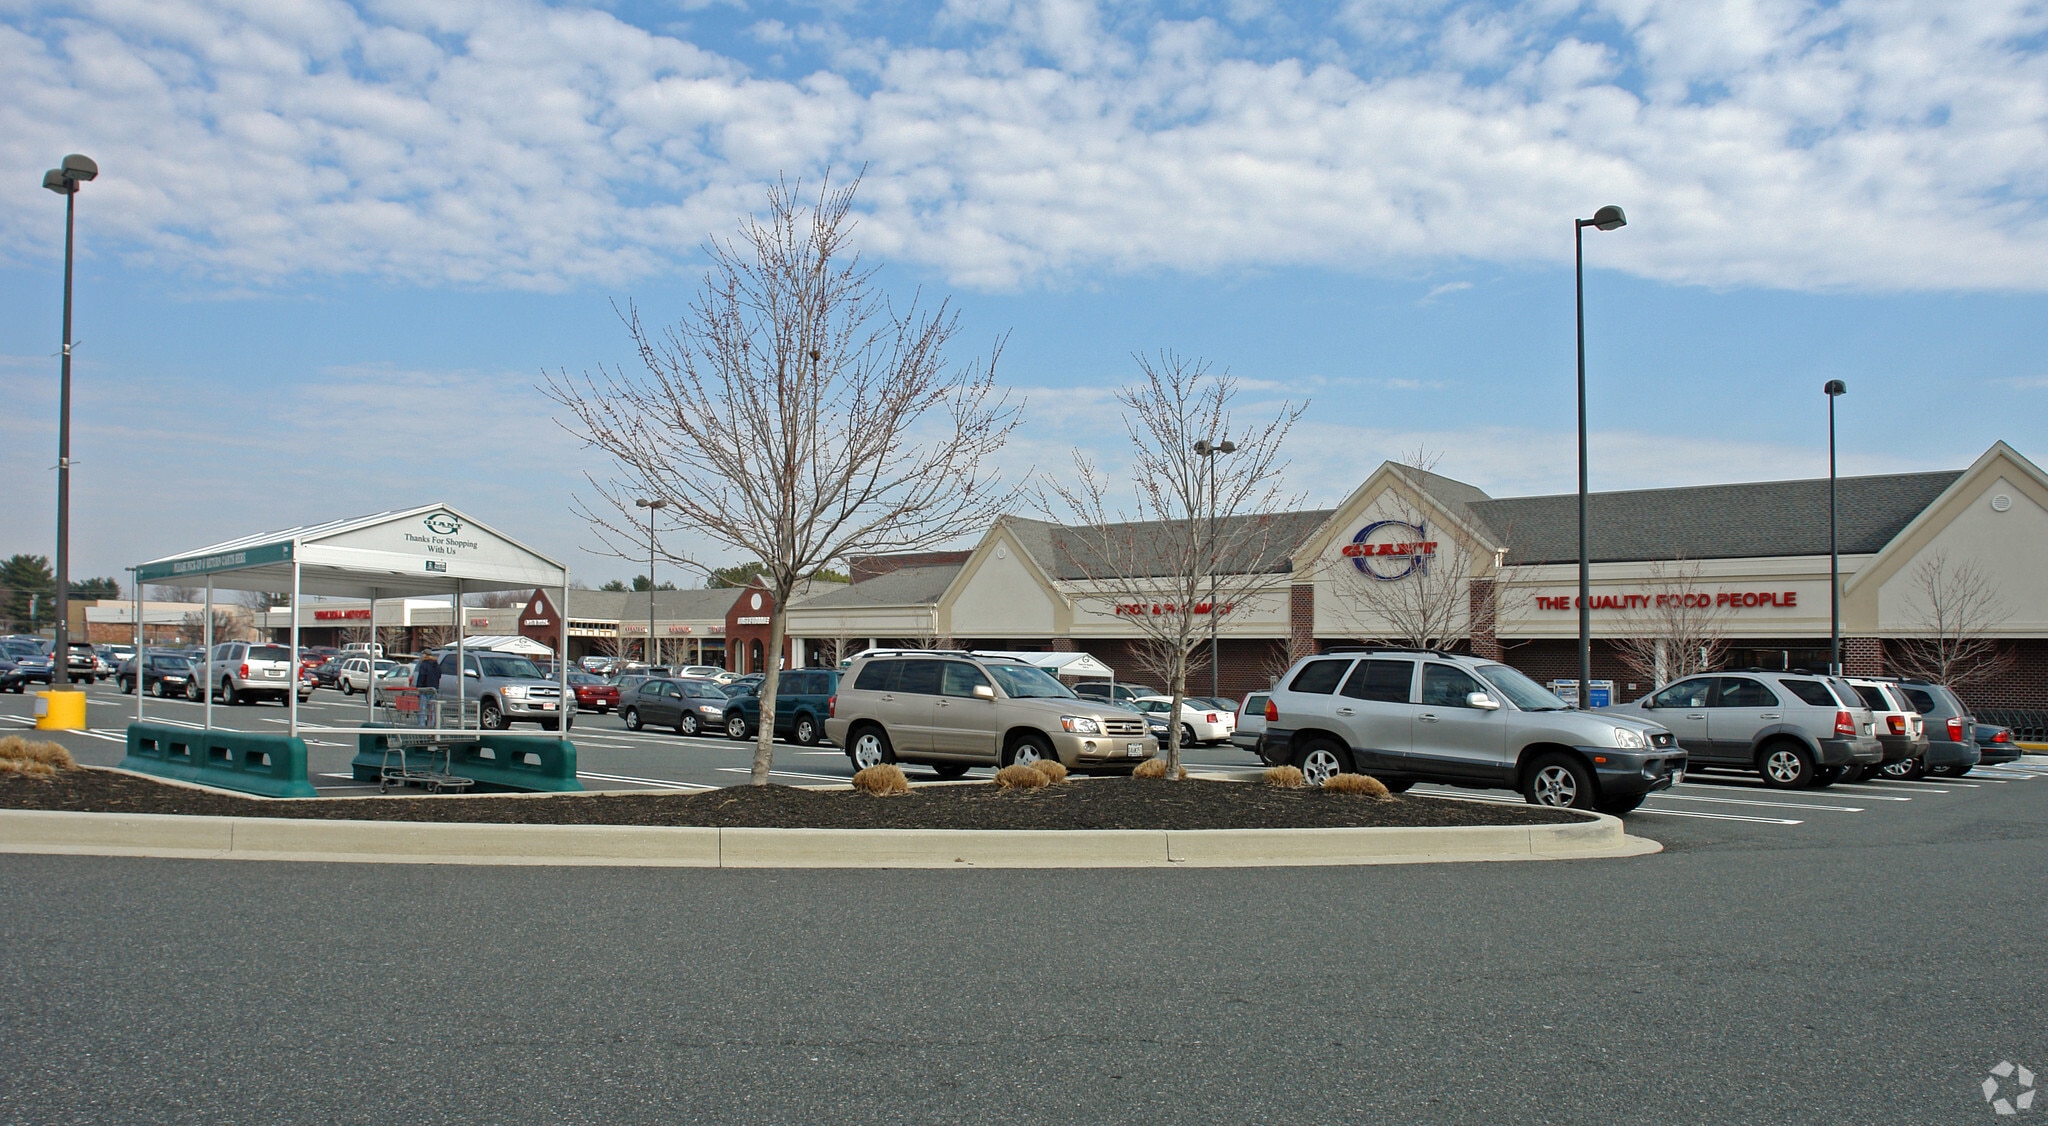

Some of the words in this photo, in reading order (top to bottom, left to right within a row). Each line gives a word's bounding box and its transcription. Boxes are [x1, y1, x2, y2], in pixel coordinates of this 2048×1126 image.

[423, 519, 463, 530] GIANT
[404, 533, 430, 543] Thanks
[432, 536, 444, 545] For
[445, 537, 478, 549] Shopping
[428, 545, 445, 554] With
[446, 546, 456, 555] Us
[1342, 542, 1438, 557] GIANT
[1536, 596, 1570, 610] THE
[1655, 593, 1711, 608] FOOD
[1717, 592, 1797, 607] PEOPLE
